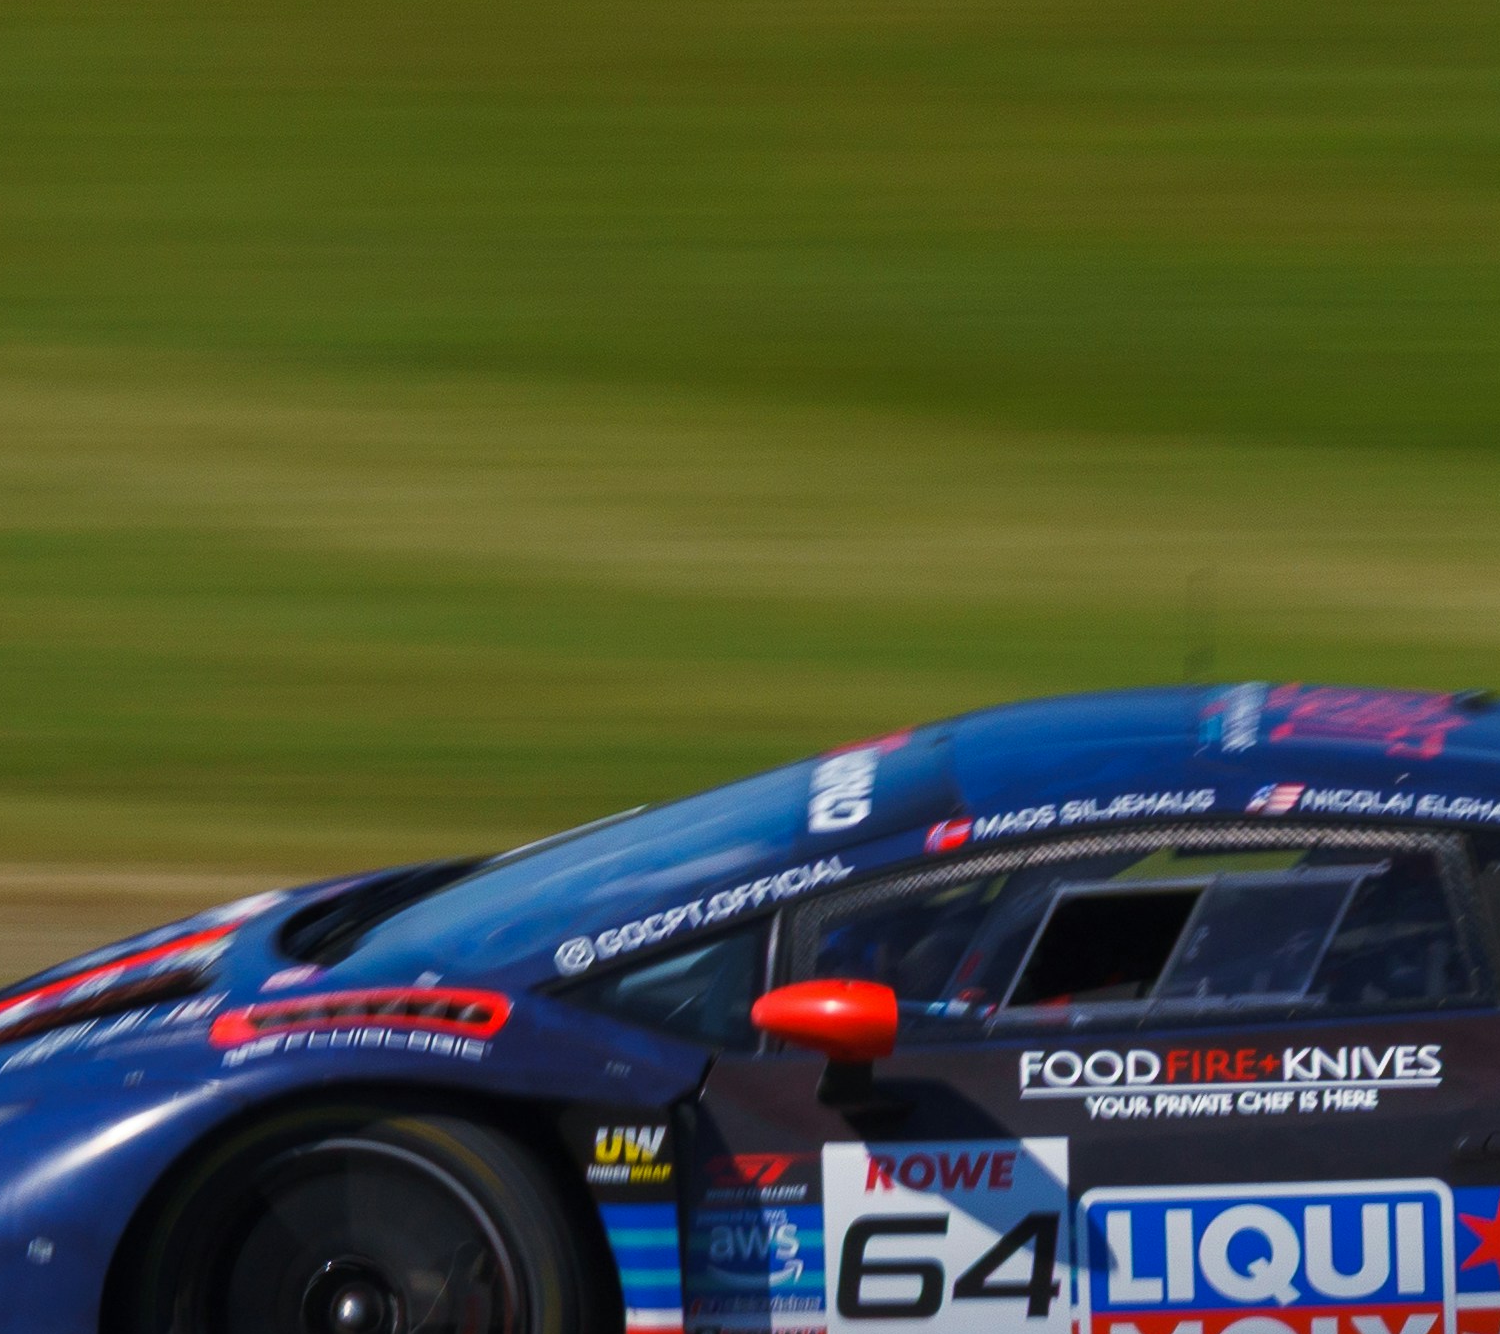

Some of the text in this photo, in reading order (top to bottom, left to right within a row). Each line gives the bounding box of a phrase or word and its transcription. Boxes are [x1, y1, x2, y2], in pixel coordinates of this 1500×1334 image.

[1086, 1087, 1380, 1121] YOUR PRIVATE CHEF IS HERE
[595, 1125, 667, 1163] UW
[864, 1151, 1017, 1193] ROWE
[708, 1223, 800, 1261] aws
[1106, 1202, 1427, 1307] LIQUI
[836, 1211, 1061, 1320] 64
